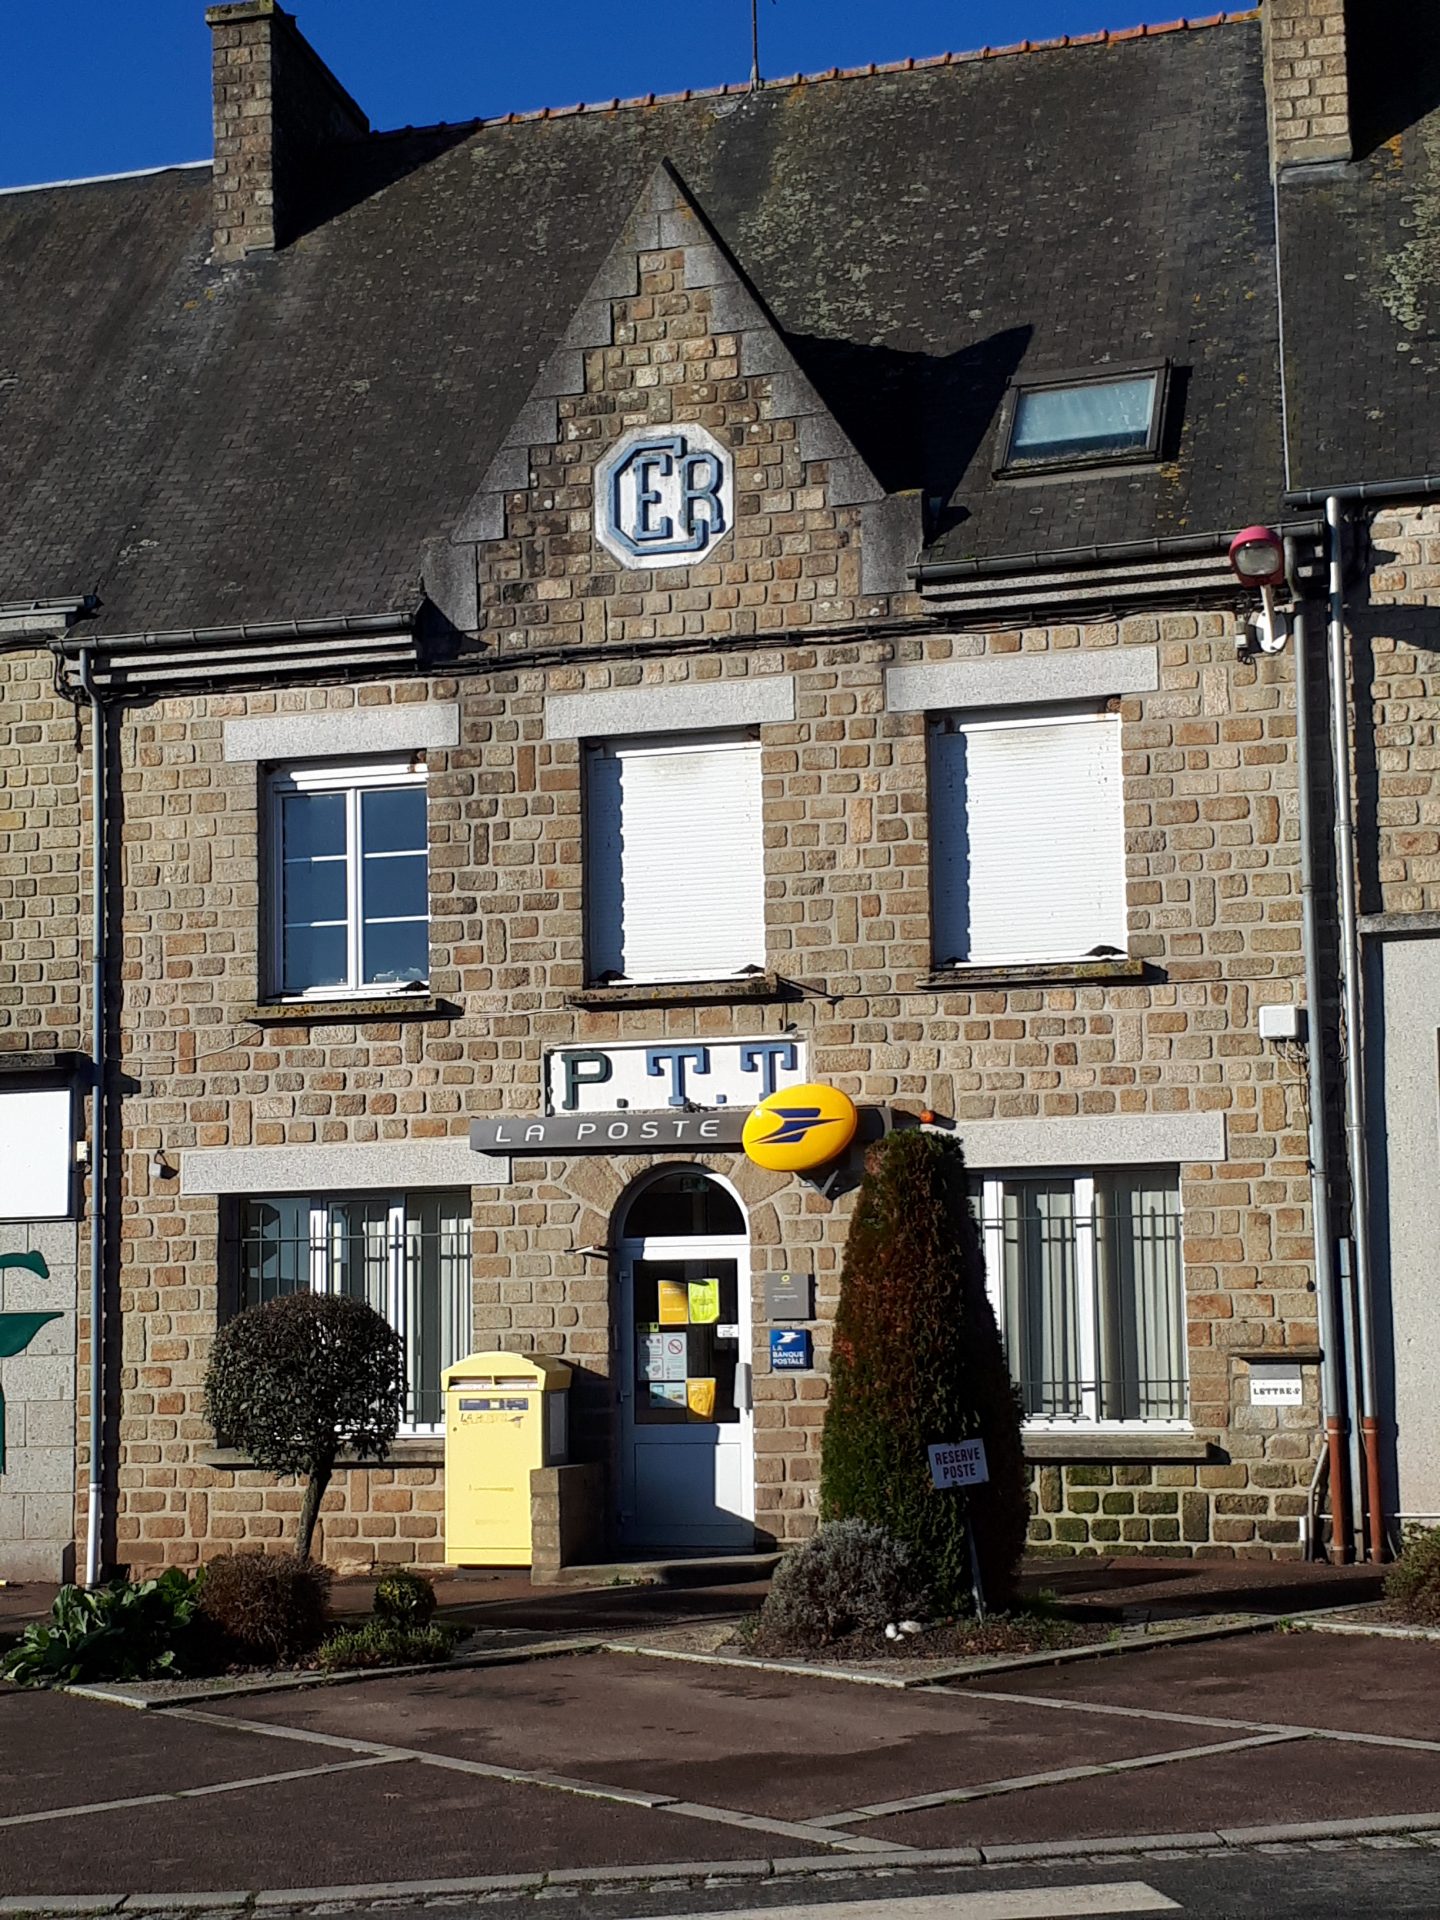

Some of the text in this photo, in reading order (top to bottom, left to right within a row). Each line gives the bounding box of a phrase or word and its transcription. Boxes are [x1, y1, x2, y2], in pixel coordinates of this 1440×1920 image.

[495, 1119, 720, 1143] LA POSTE
[772, 1358, 804, 1366] POSTALE
[935, 1447, 980, 1466] RESERVE
[943, 1463, 976, 1480] POSTE
